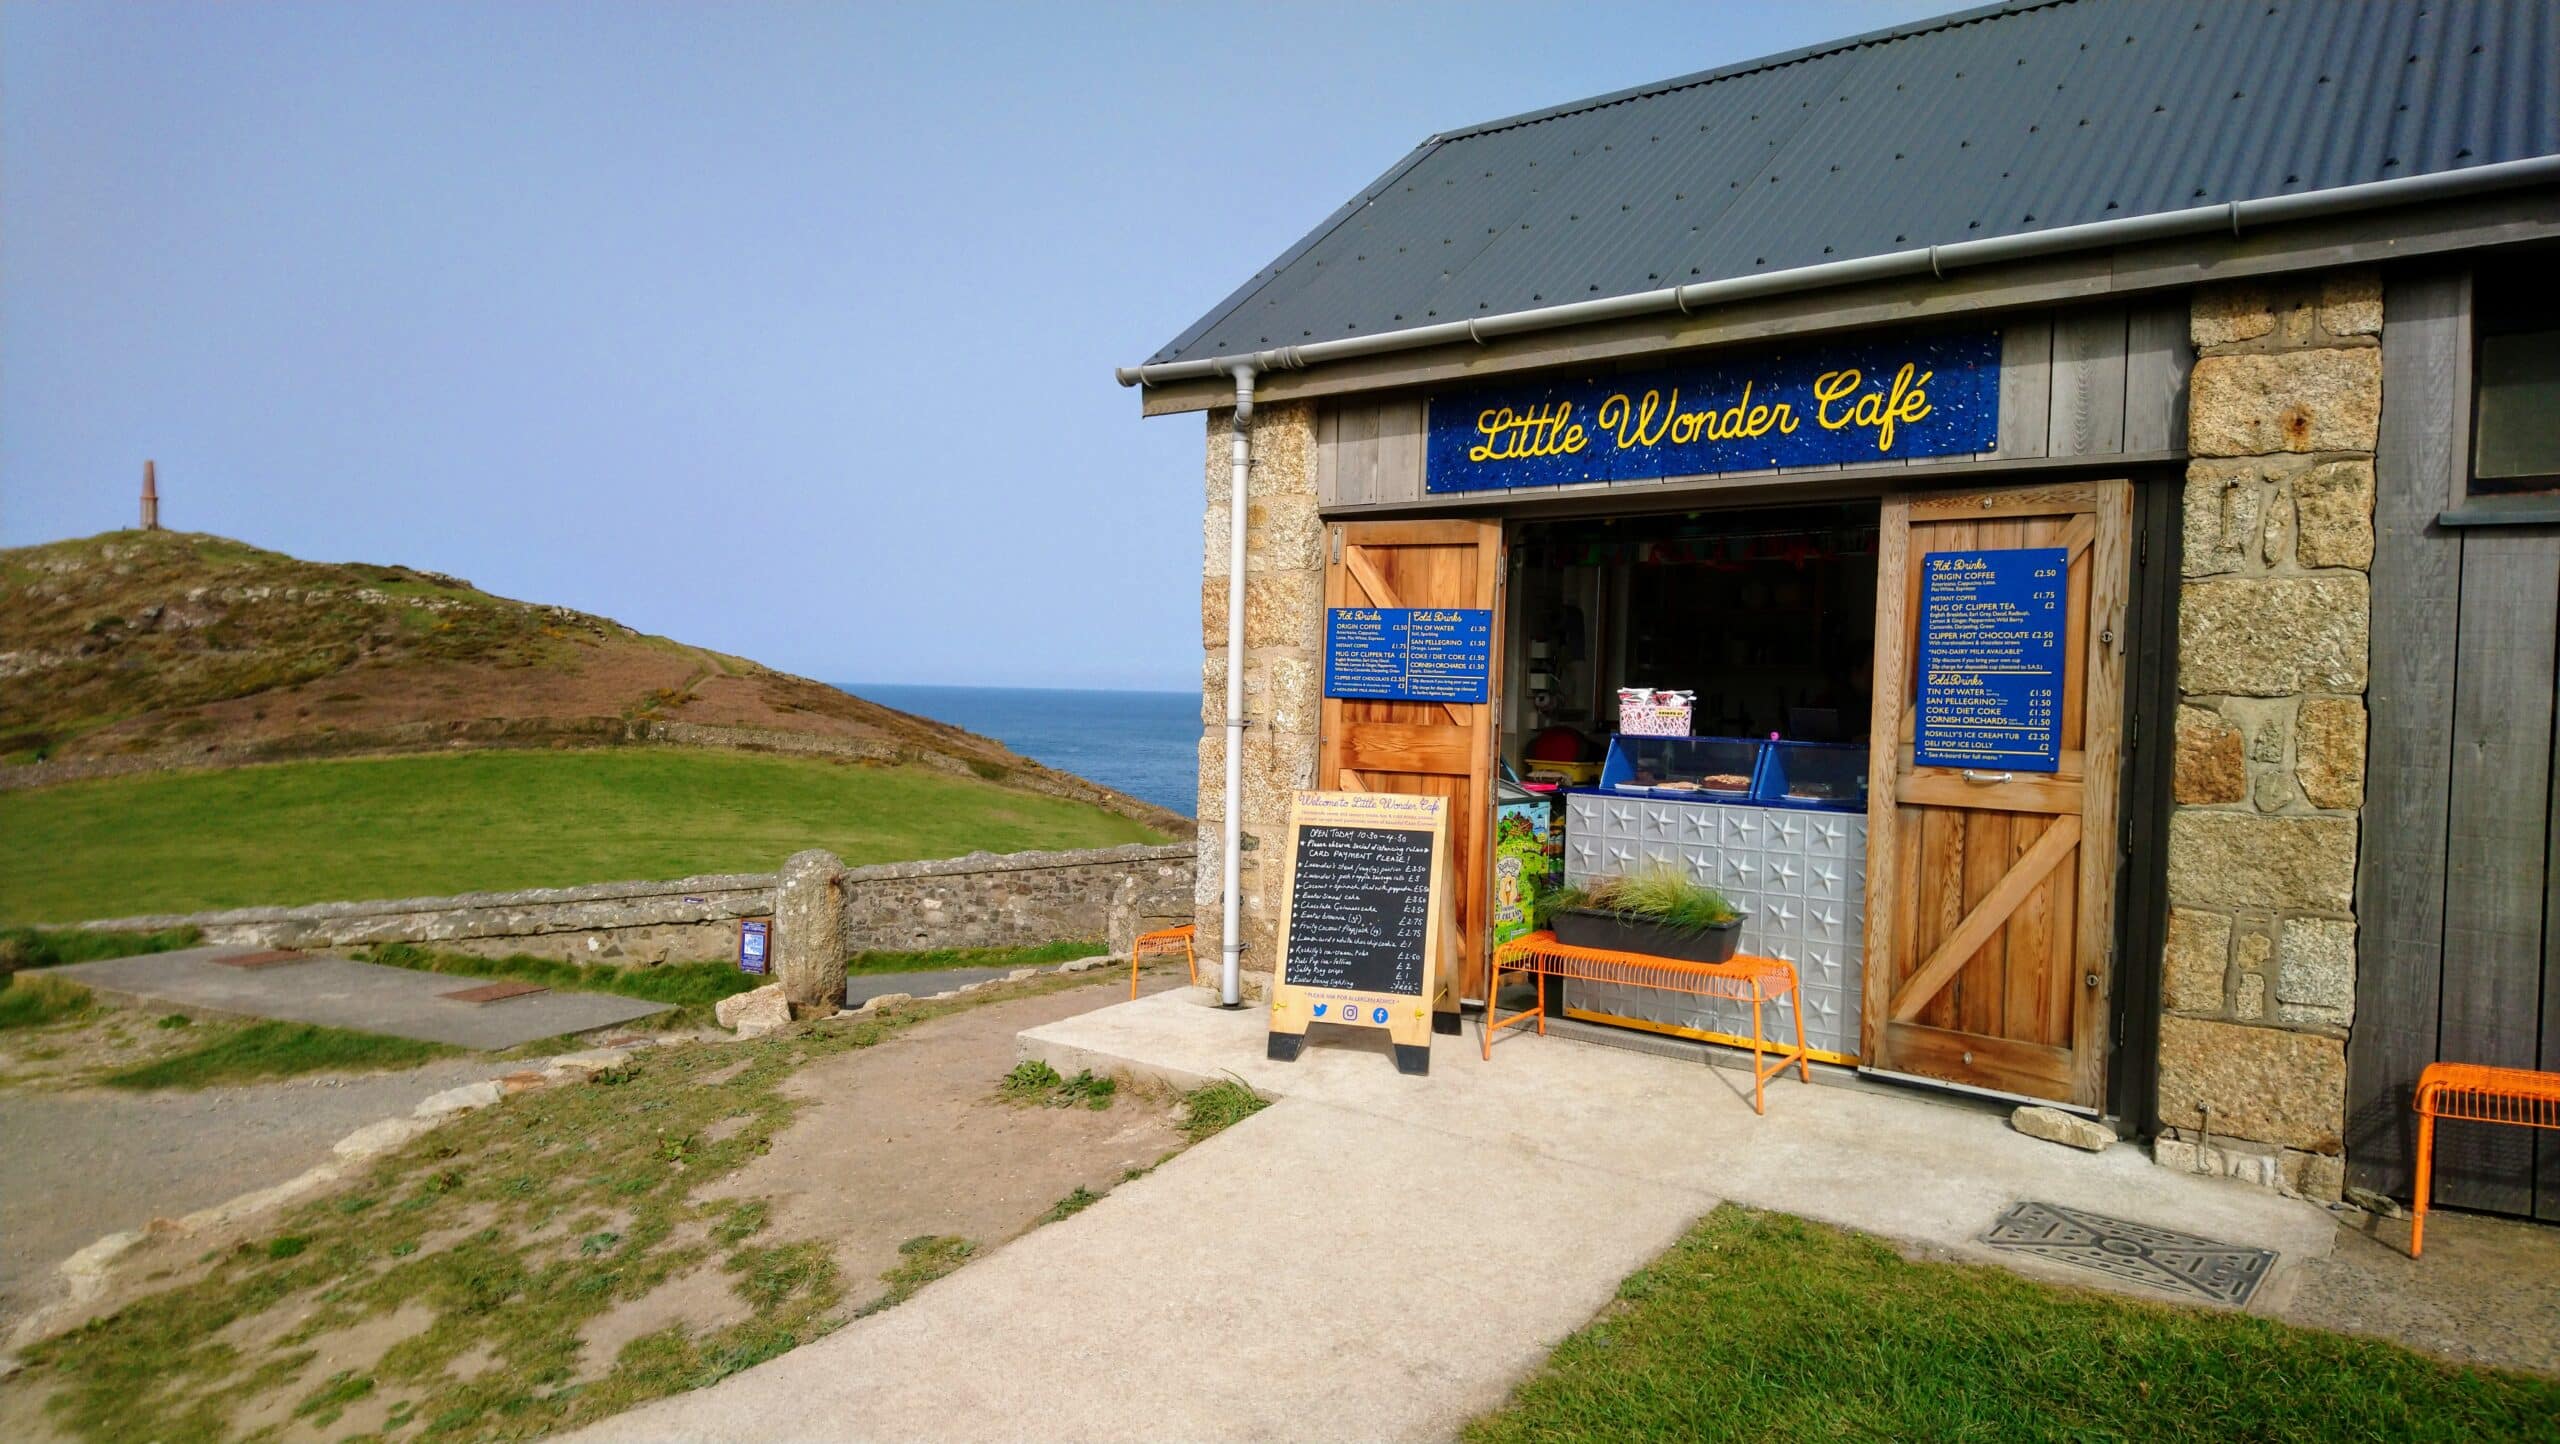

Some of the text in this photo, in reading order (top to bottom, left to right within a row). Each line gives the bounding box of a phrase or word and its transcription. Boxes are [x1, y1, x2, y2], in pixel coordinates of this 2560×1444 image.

[1469, 361, 1934, 461] Little Wonder Café
[1933, 558, 1987, 571] Hot Drinks
[1932, 572, 1962, 580] ORIGIN
[1964, 572, 1996, 580] COFFEE
[1434, 611, 1462, 622] Drinks
[1928, 674, 1984, 686] Cold Drinks
[1946, 698, 1996, 706] PELLEGRINO
[1962, 716, 2008, 725] ORCHARDS
[1299, 795, 1338, 806] Welcome
[1351, 796, 1376, 808] Little
[1379, 798, 1417, 810] Wonder
[1310, 828, 1328, 838] OPEN
[1330, 828, 1354, 841] TODAY
[1307, 839, 1326, 848] Please
[1371, 844, 1404, 856] distancing
[1333, 850, 1372, 860] PAYMENT
[1300, 921, 1318, 934] Fruity
[1342, 924, 1368, 936] flapjack
[1297, 933, 1318, 942] Lemon
[1294, 964, 1311, 976] Salty
[1313, 966, 1326, 976] Dog
[1330, 978, 1354, 988] sighting
